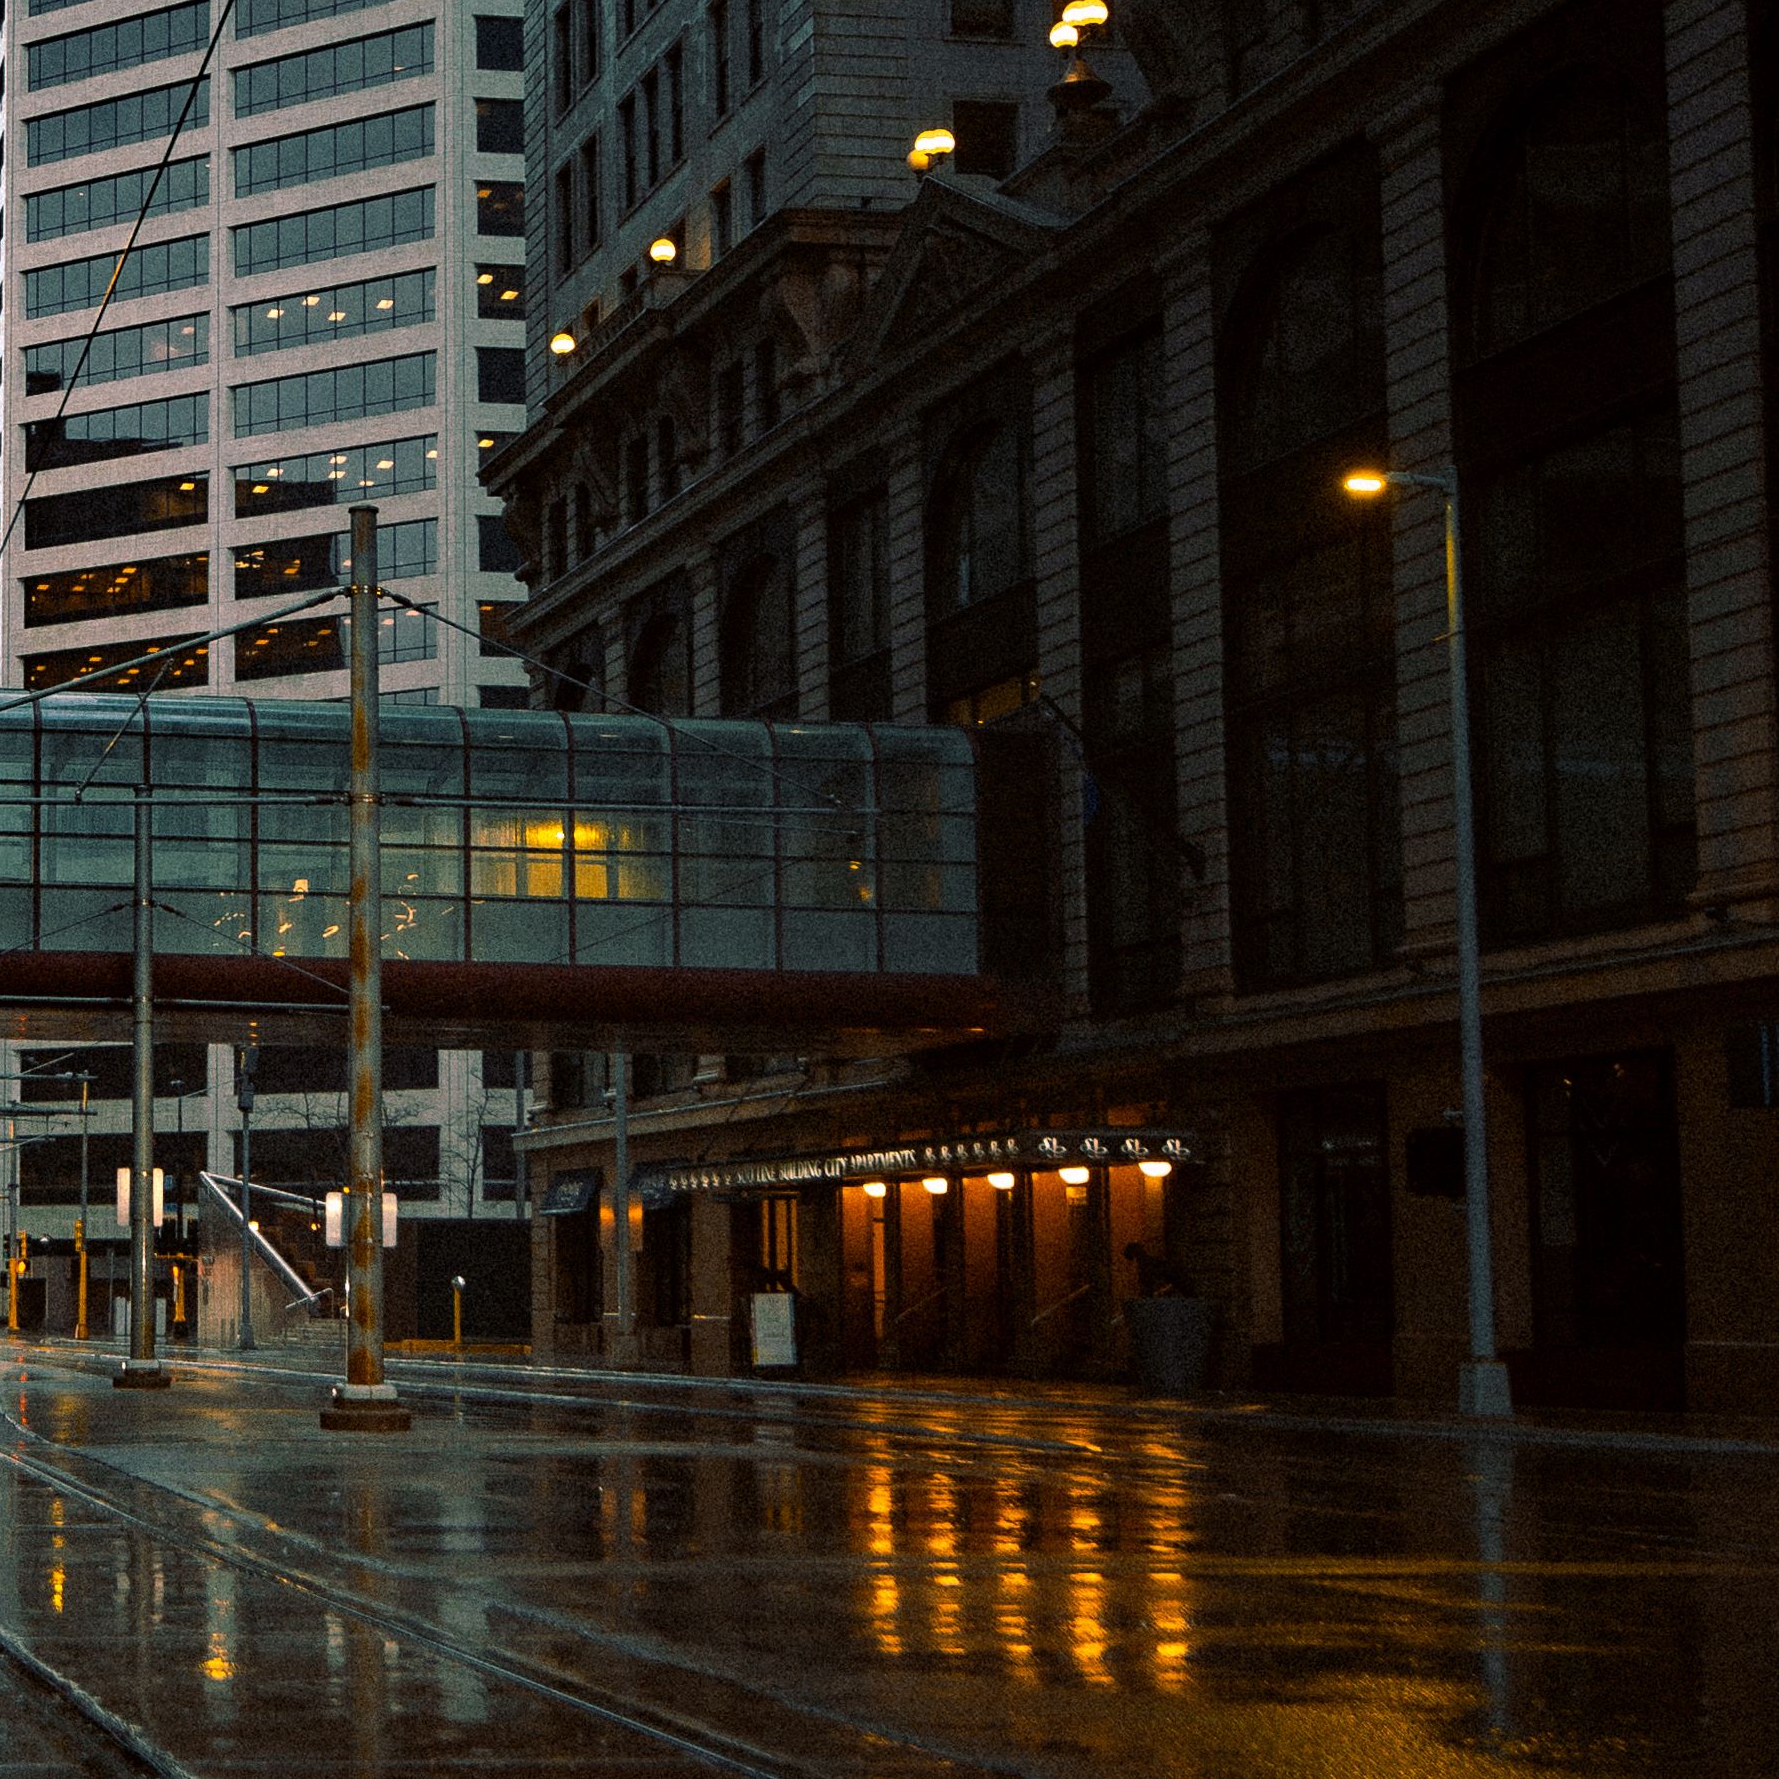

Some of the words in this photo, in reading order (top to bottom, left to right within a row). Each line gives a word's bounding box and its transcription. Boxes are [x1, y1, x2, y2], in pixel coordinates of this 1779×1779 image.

[756, 1165, 777, 1183] LINE
[778, 1159, 823, 1181] BUILDING
[824, 1157, 848, 1178] CITY
[850, 1149, 917, 1172] APARTMENTS
